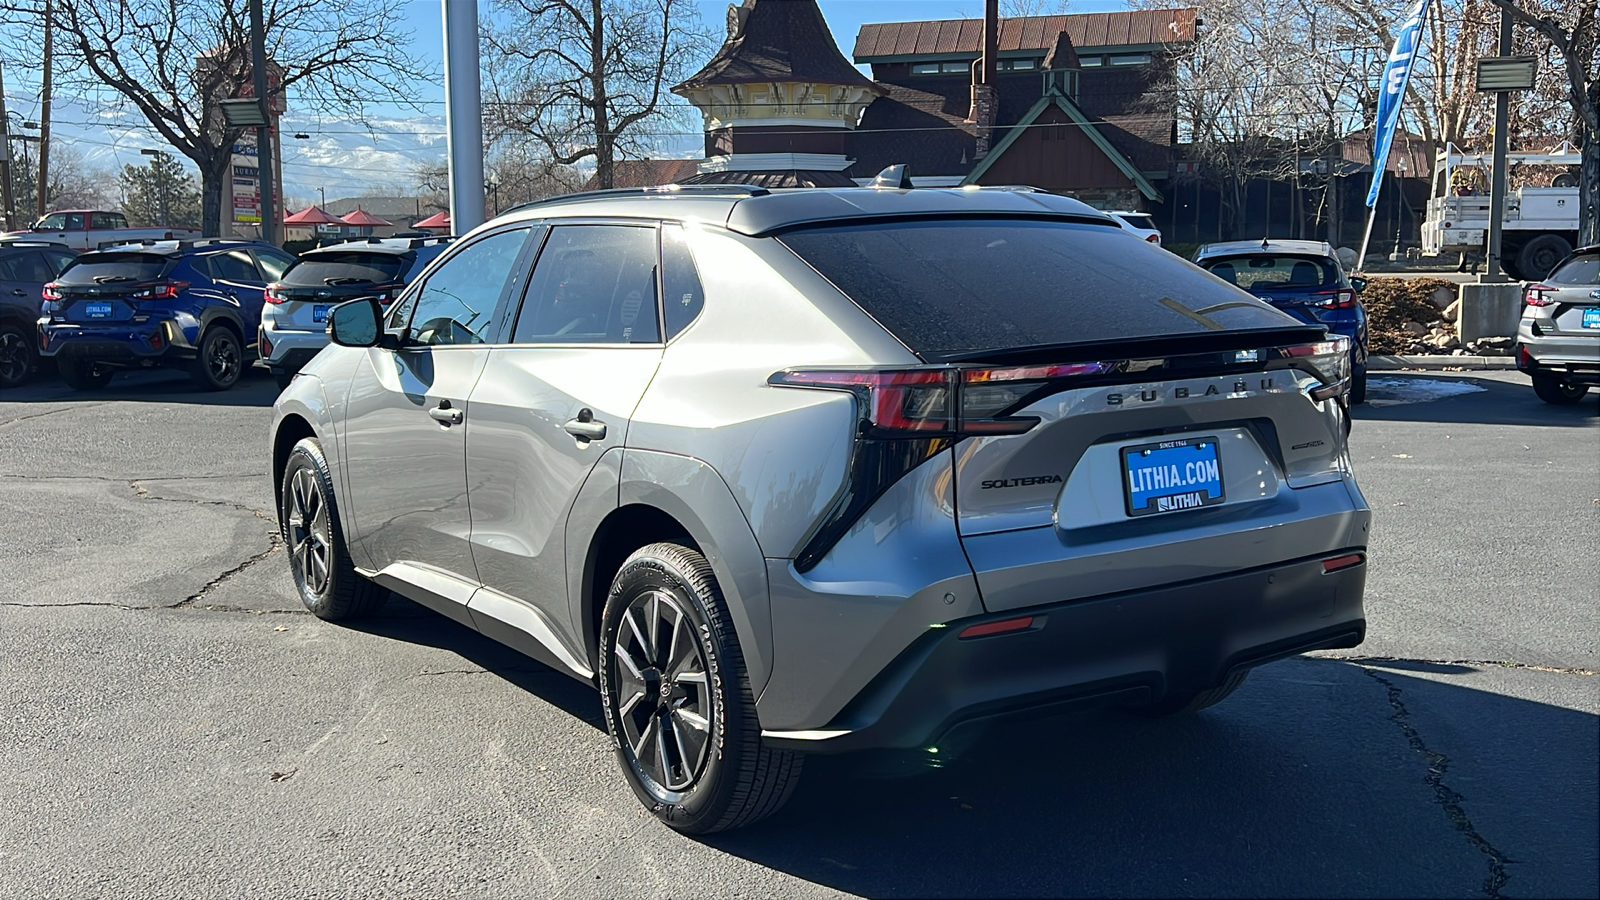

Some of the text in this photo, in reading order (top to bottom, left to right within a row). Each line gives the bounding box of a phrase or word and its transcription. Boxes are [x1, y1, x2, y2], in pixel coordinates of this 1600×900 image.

[1106, 378, 1274, 405] SUBARU
[1159, 441, 1175, 449] SINCE
[981, 474, 1063, 489] SOLTERRA
[1129, 459, 1220, 493] LITHIA.COM
[1168, 492, 1203, 510] LITHIA
[622, 561, 665, 577] TURANZA
